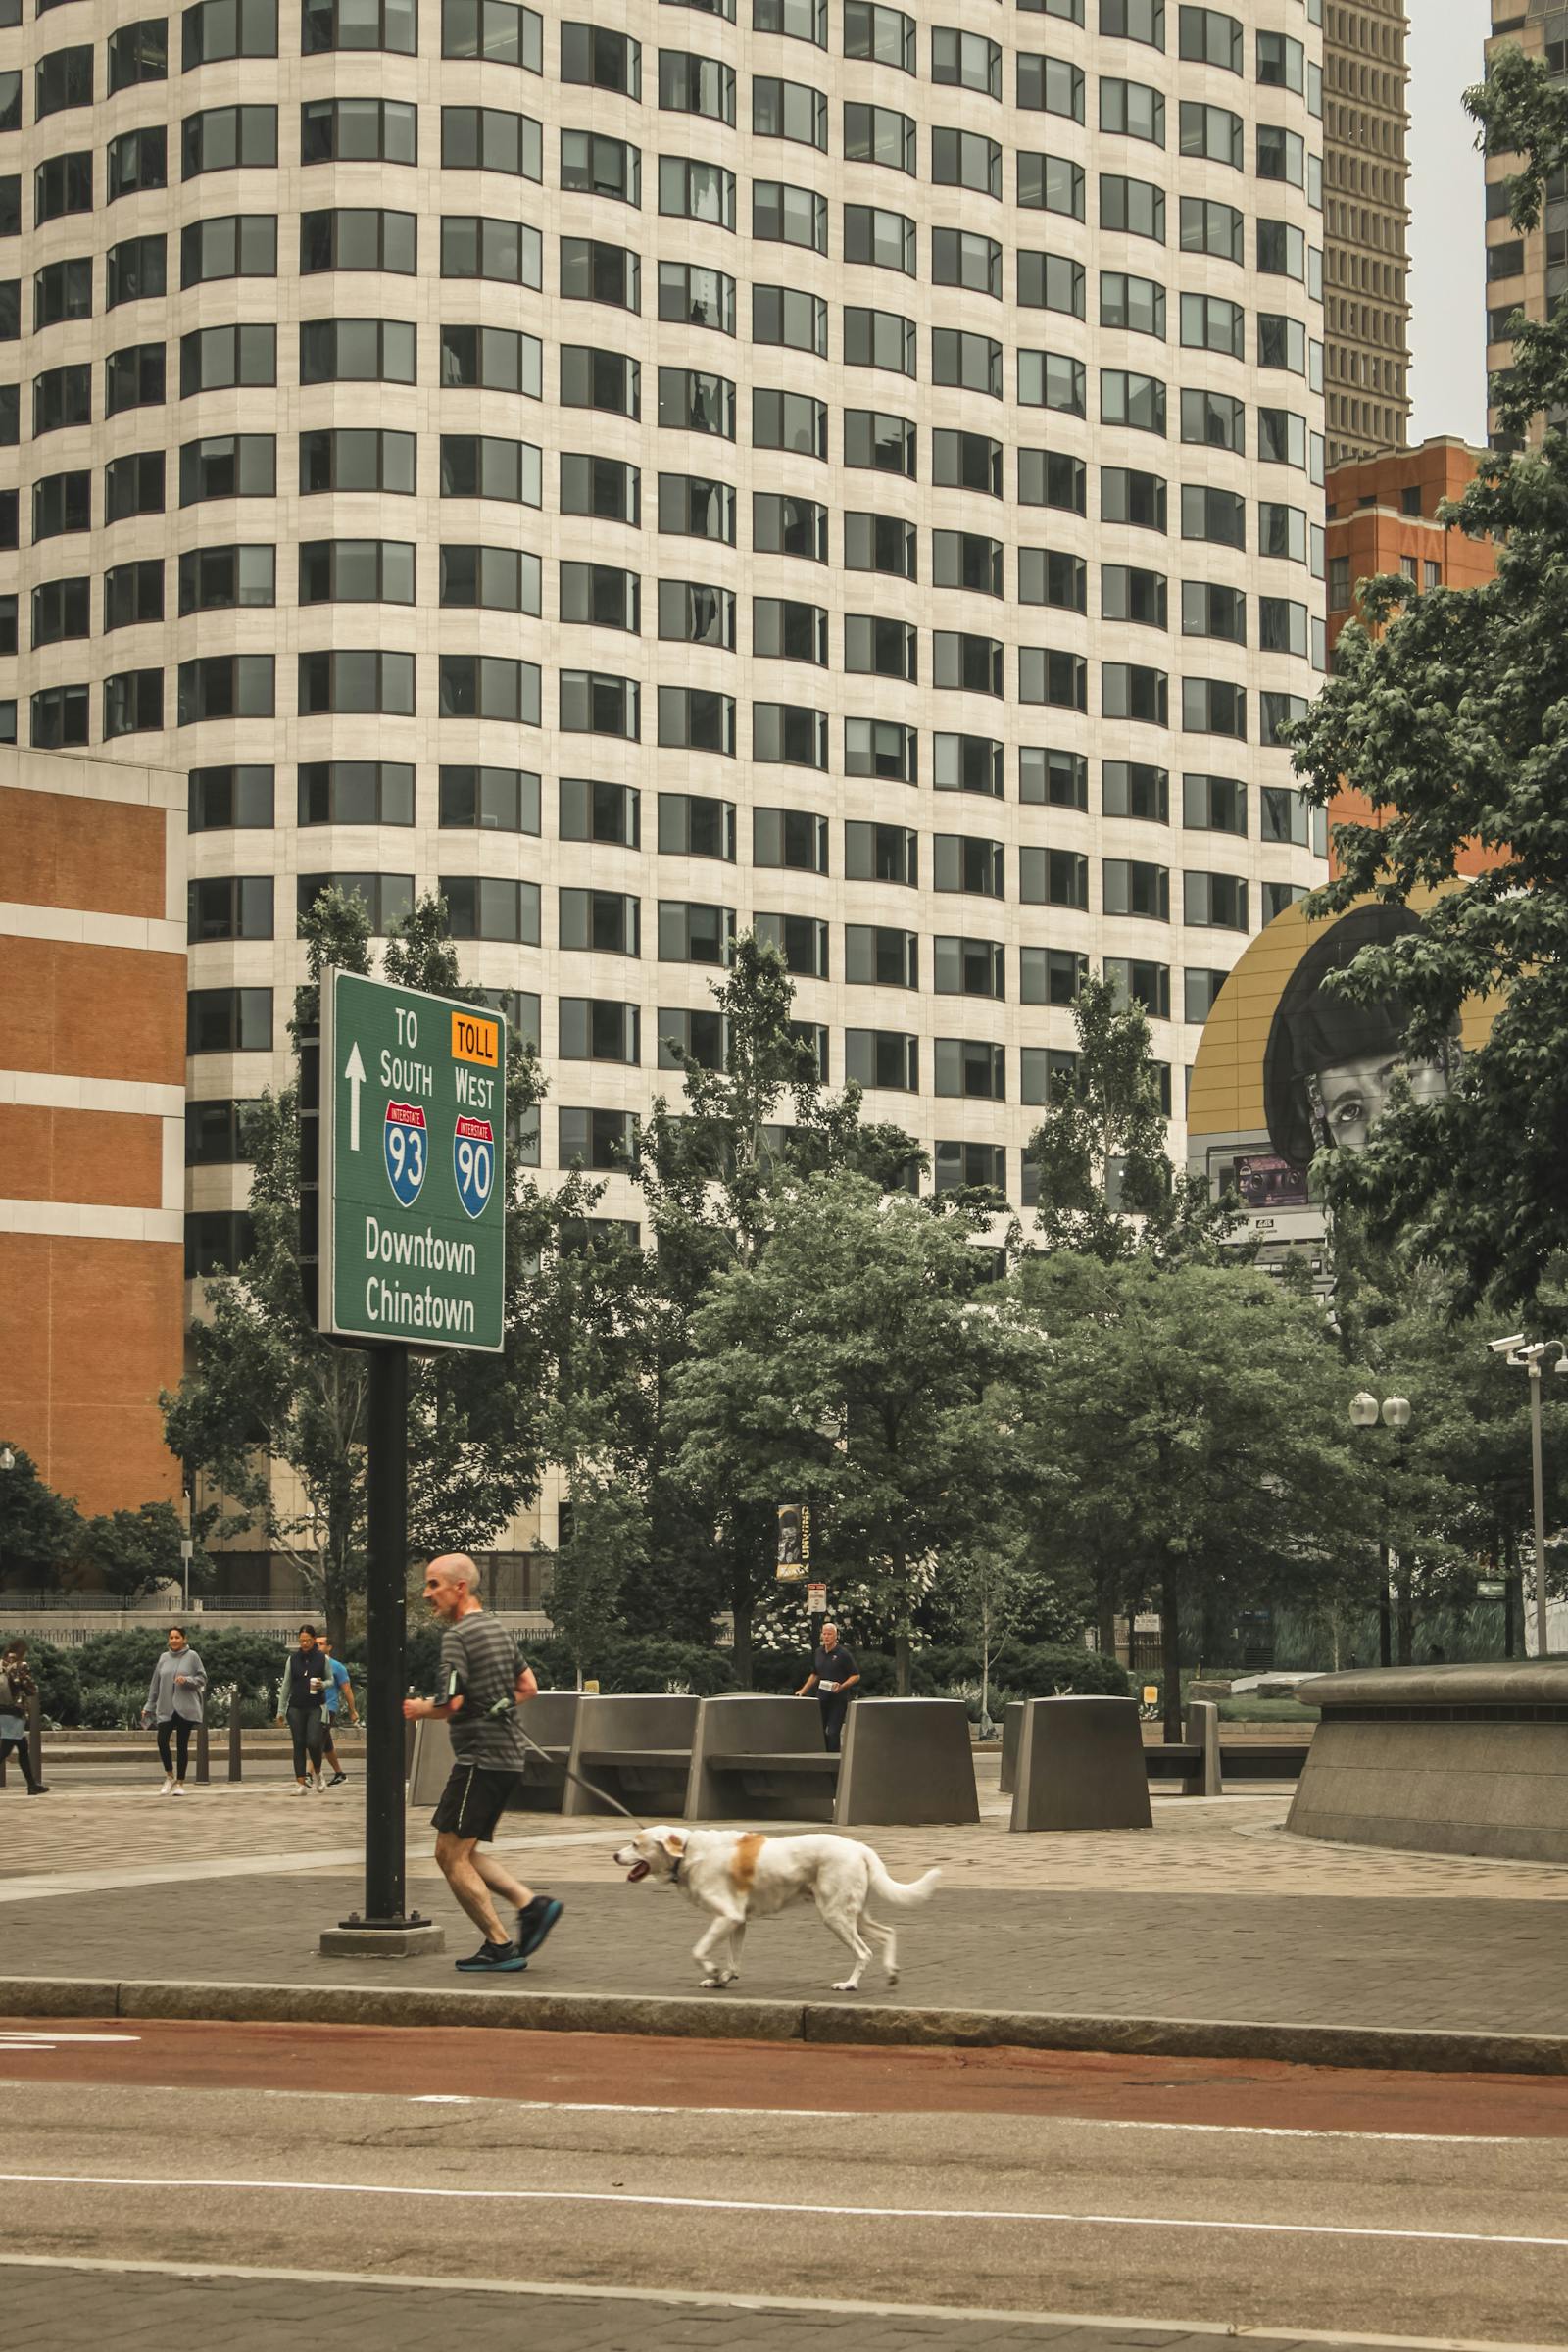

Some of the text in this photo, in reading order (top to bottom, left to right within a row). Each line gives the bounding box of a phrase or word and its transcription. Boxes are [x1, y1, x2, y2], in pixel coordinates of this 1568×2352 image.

[395, 1007, 418, 1049] TO
[457, 1021, 493, 1059] TOLL
[380, 1049, 433, 1097] SOUTH
[455, 1066, 495, 1110] WEST
[391, 1108, 421, 1125] INTERSTATE
[461, 1123, 489, 1139] INTERSTATE
[389, 1128, 423, 1186] 93
[458, 1141, 490, 1199] 90
[366, 1216, 476, 1276] Downtown
[366, 1276, 474, 1333] Chinatown
